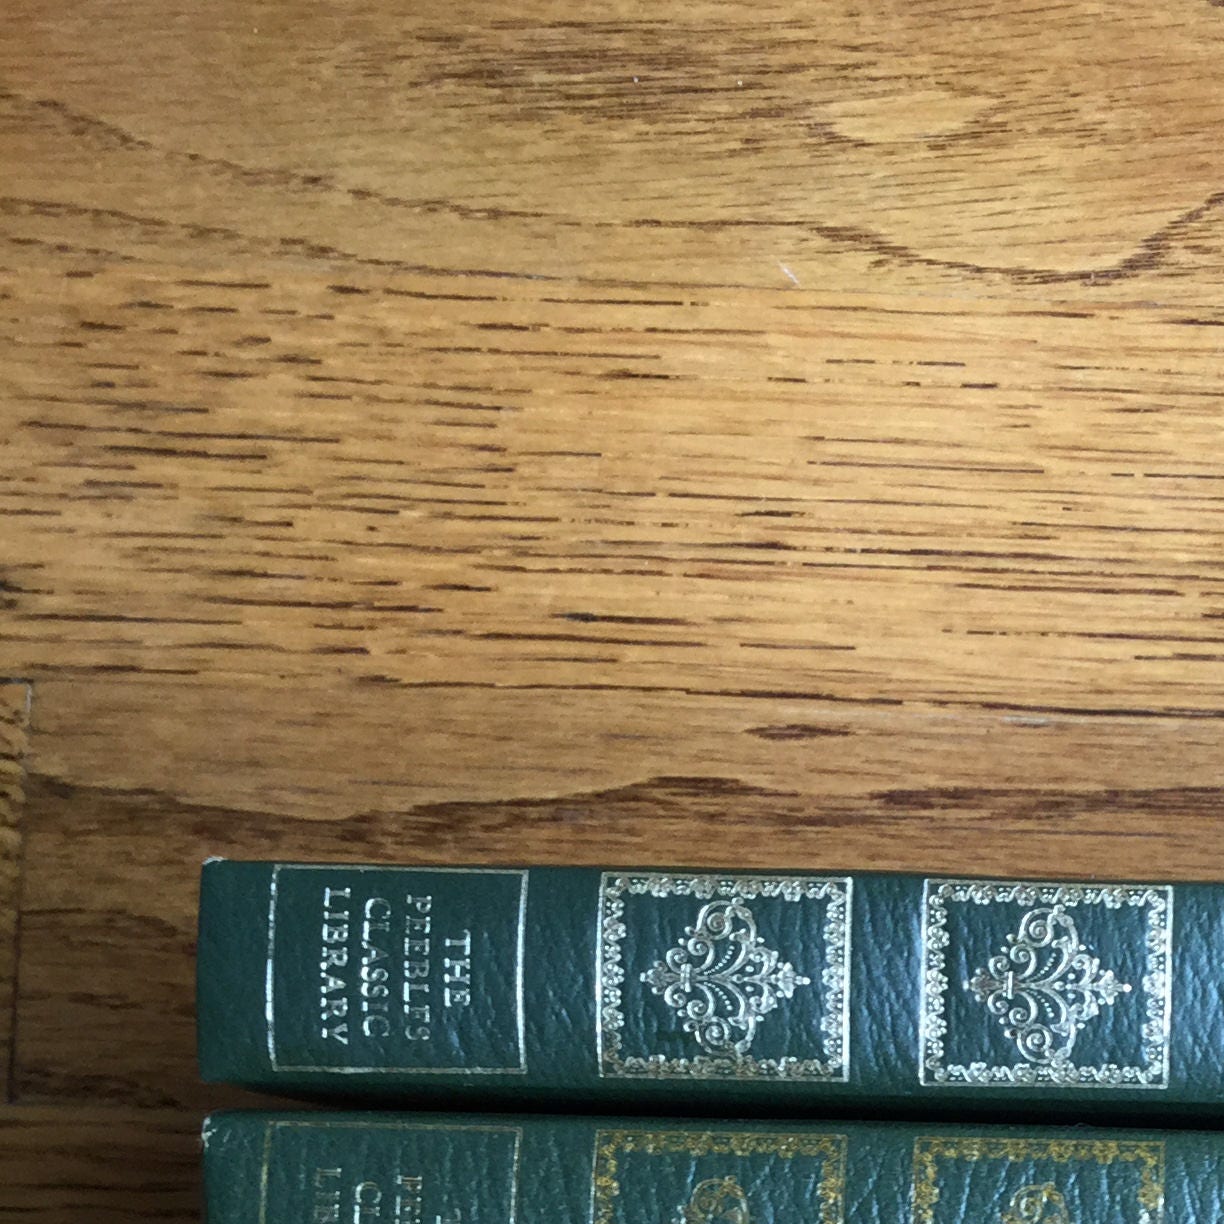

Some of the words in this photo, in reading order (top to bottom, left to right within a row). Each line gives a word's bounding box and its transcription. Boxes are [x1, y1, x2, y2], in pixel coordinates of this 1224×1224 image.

[320, 887, 351, 1045] LIBRARY
[360, 898, 391, 1036] CLASSIC
[444, 928, 471, 1007] THE
